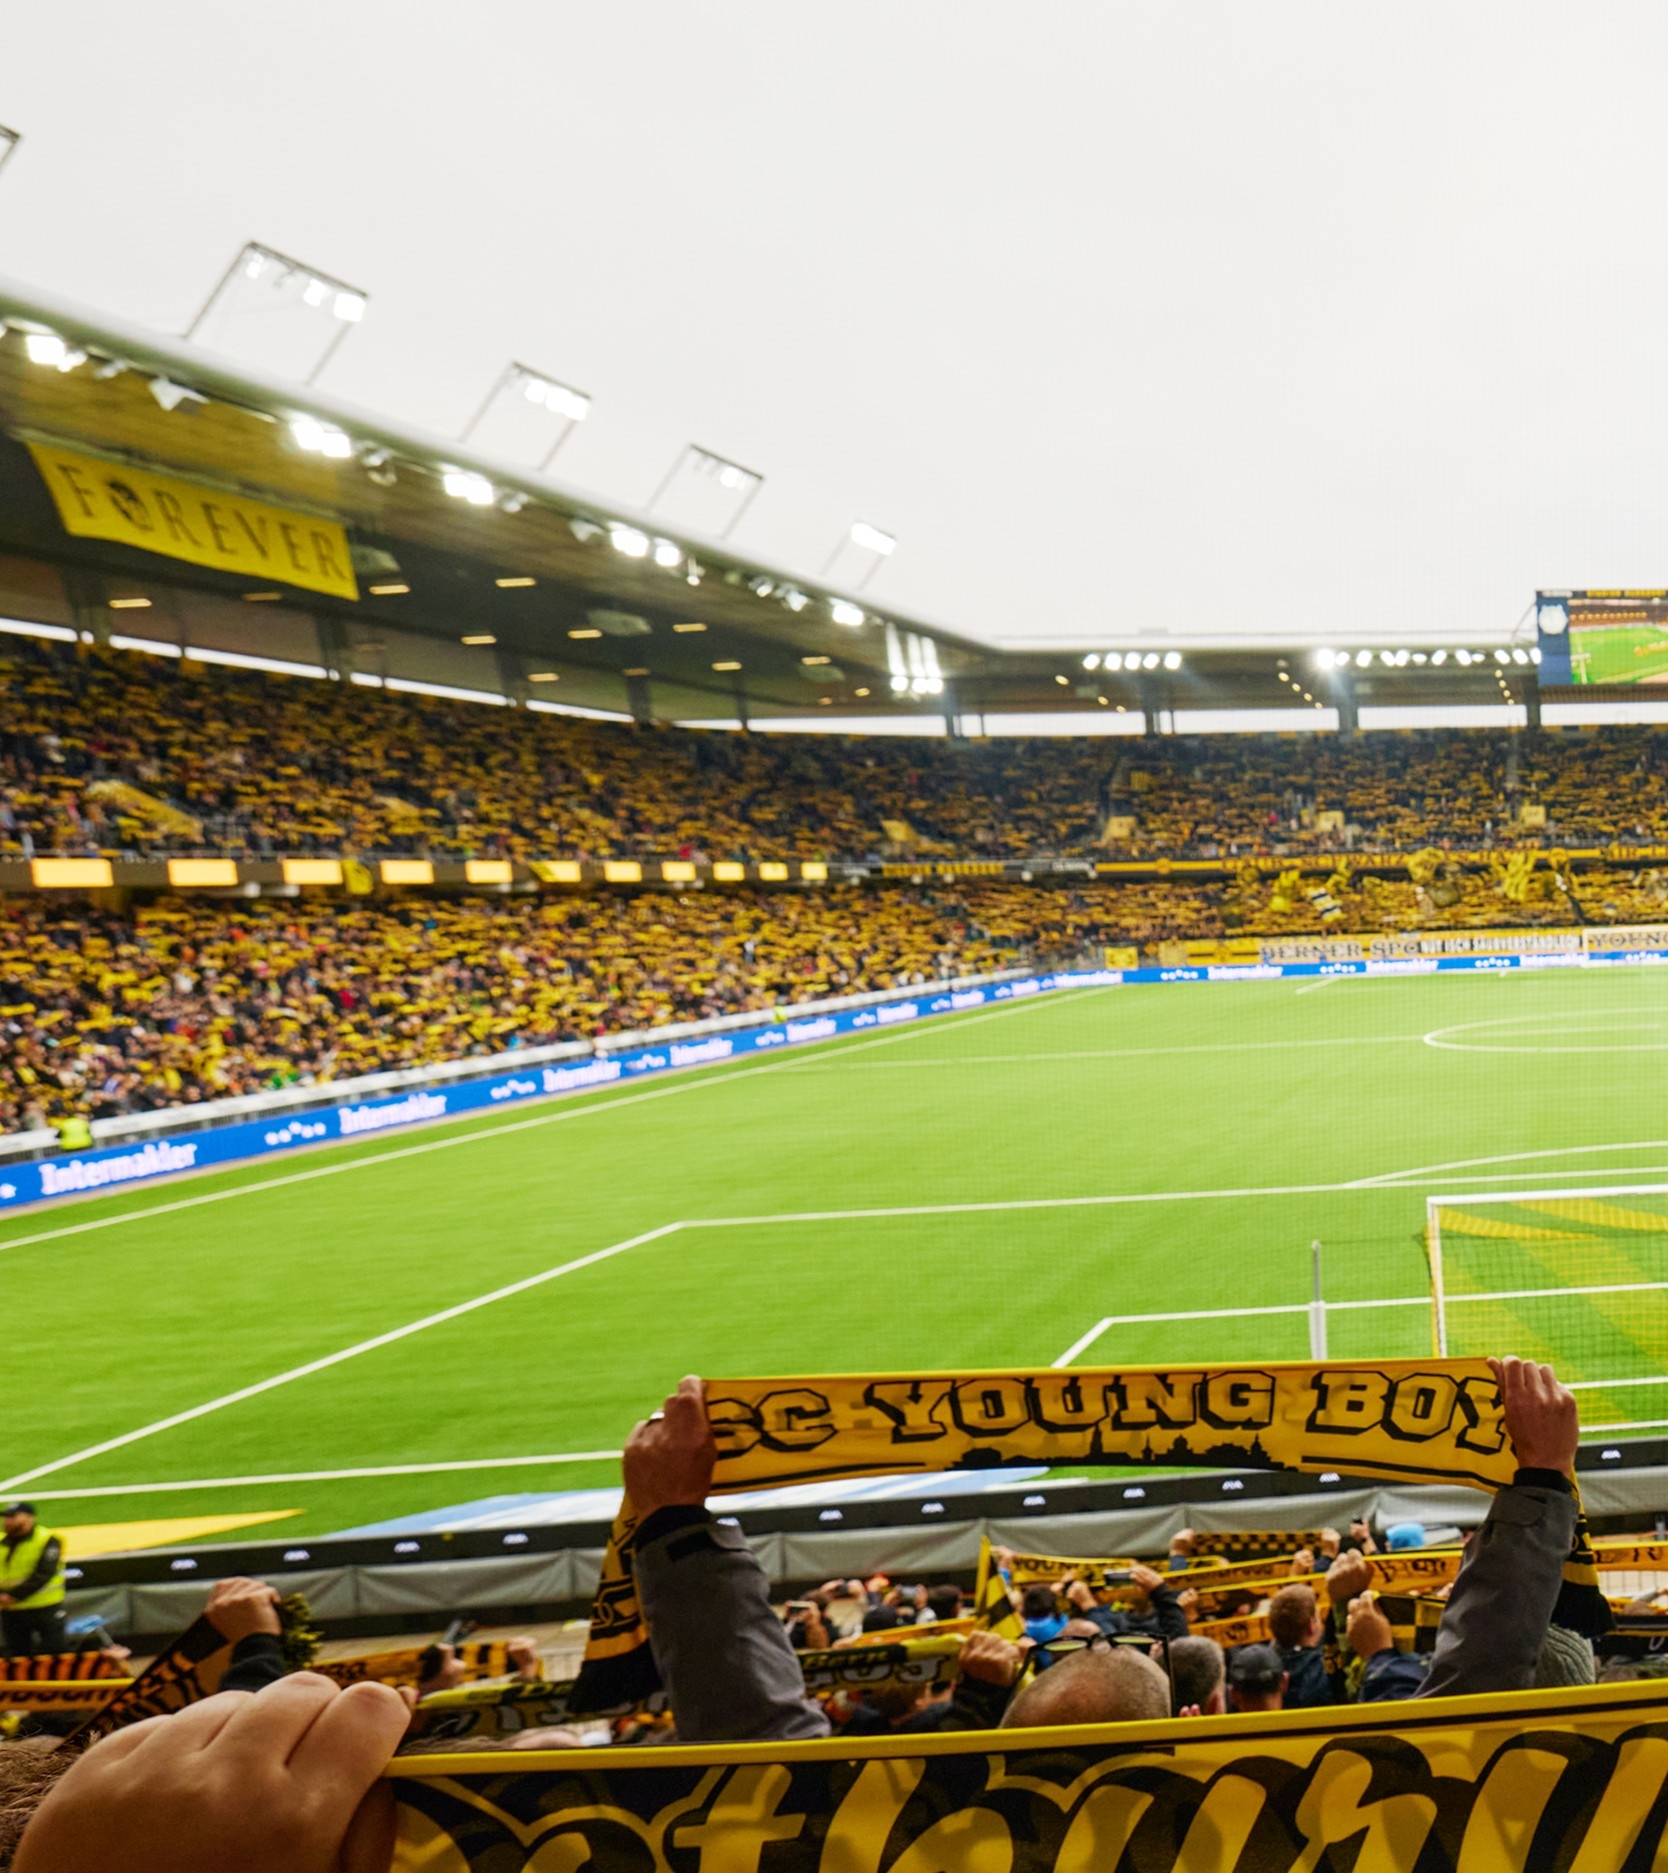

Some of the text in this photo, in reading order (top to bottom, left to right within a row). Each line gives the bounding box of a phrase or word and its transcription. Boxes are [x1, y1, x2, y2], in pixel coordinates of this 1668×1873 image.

[57, 464, 349, 581] FOREVER
[38, 1141, 198, 1195] Intermakler
[862, 1369, 1277, 1444] YOUNG
